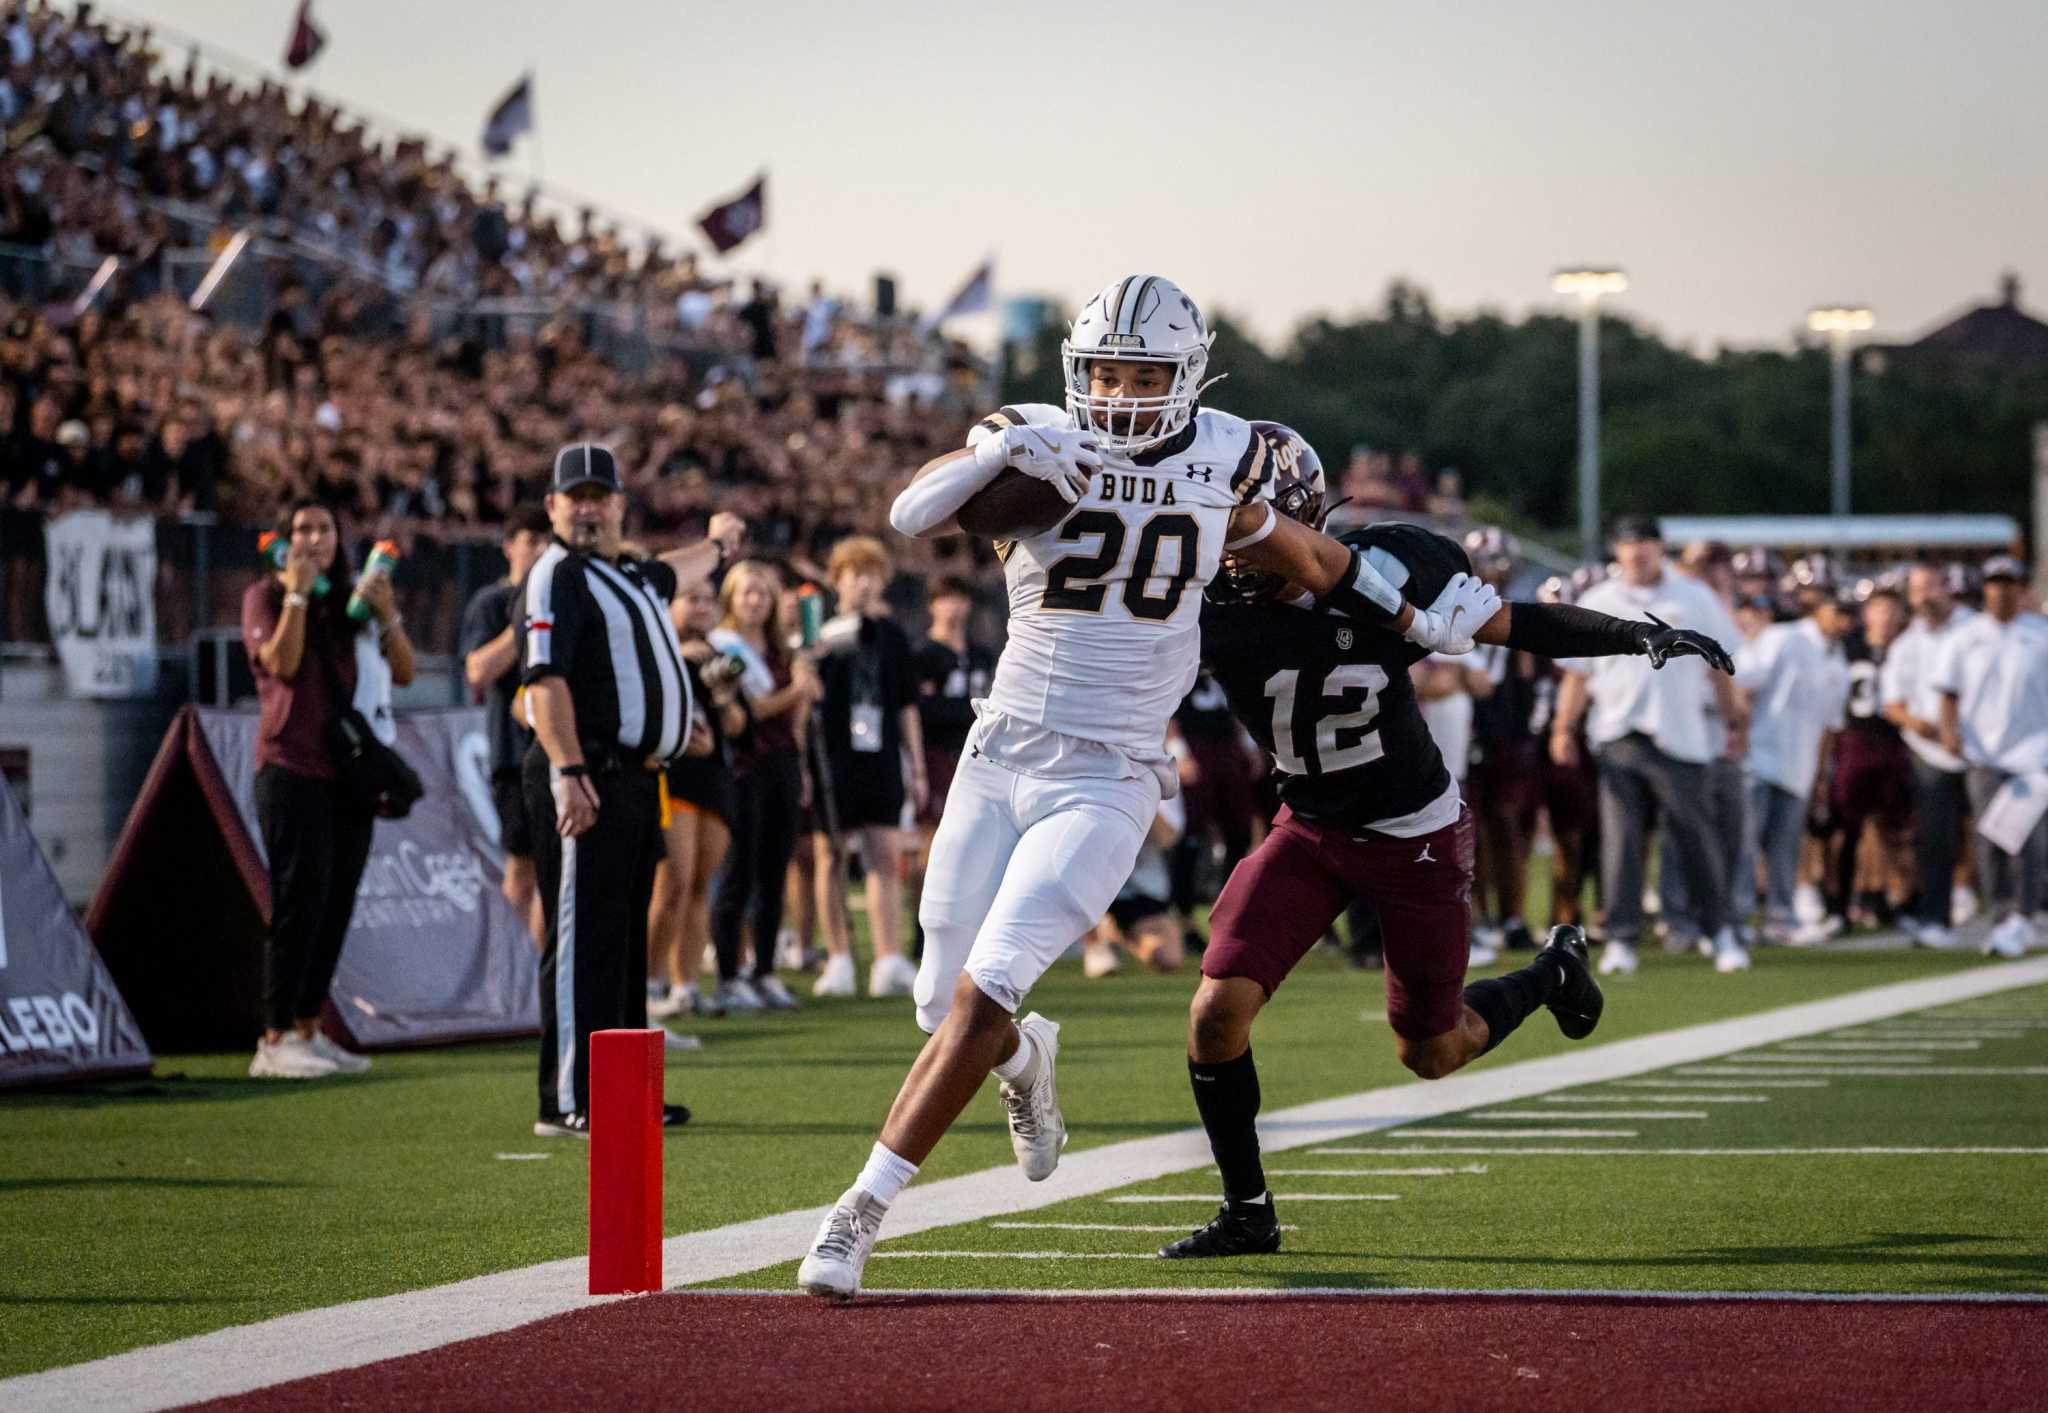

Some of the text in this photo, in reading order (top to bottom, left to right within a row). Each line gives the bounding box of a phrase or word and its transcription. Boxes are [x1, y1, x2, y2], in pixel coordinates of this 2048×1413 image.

[1101, 473, 1176, 505] BUDA
[1039, 508, 1200, 624] 20
[1264, 664, 1389, 775] 12
[0, 992, 98, 1054] LEBO
